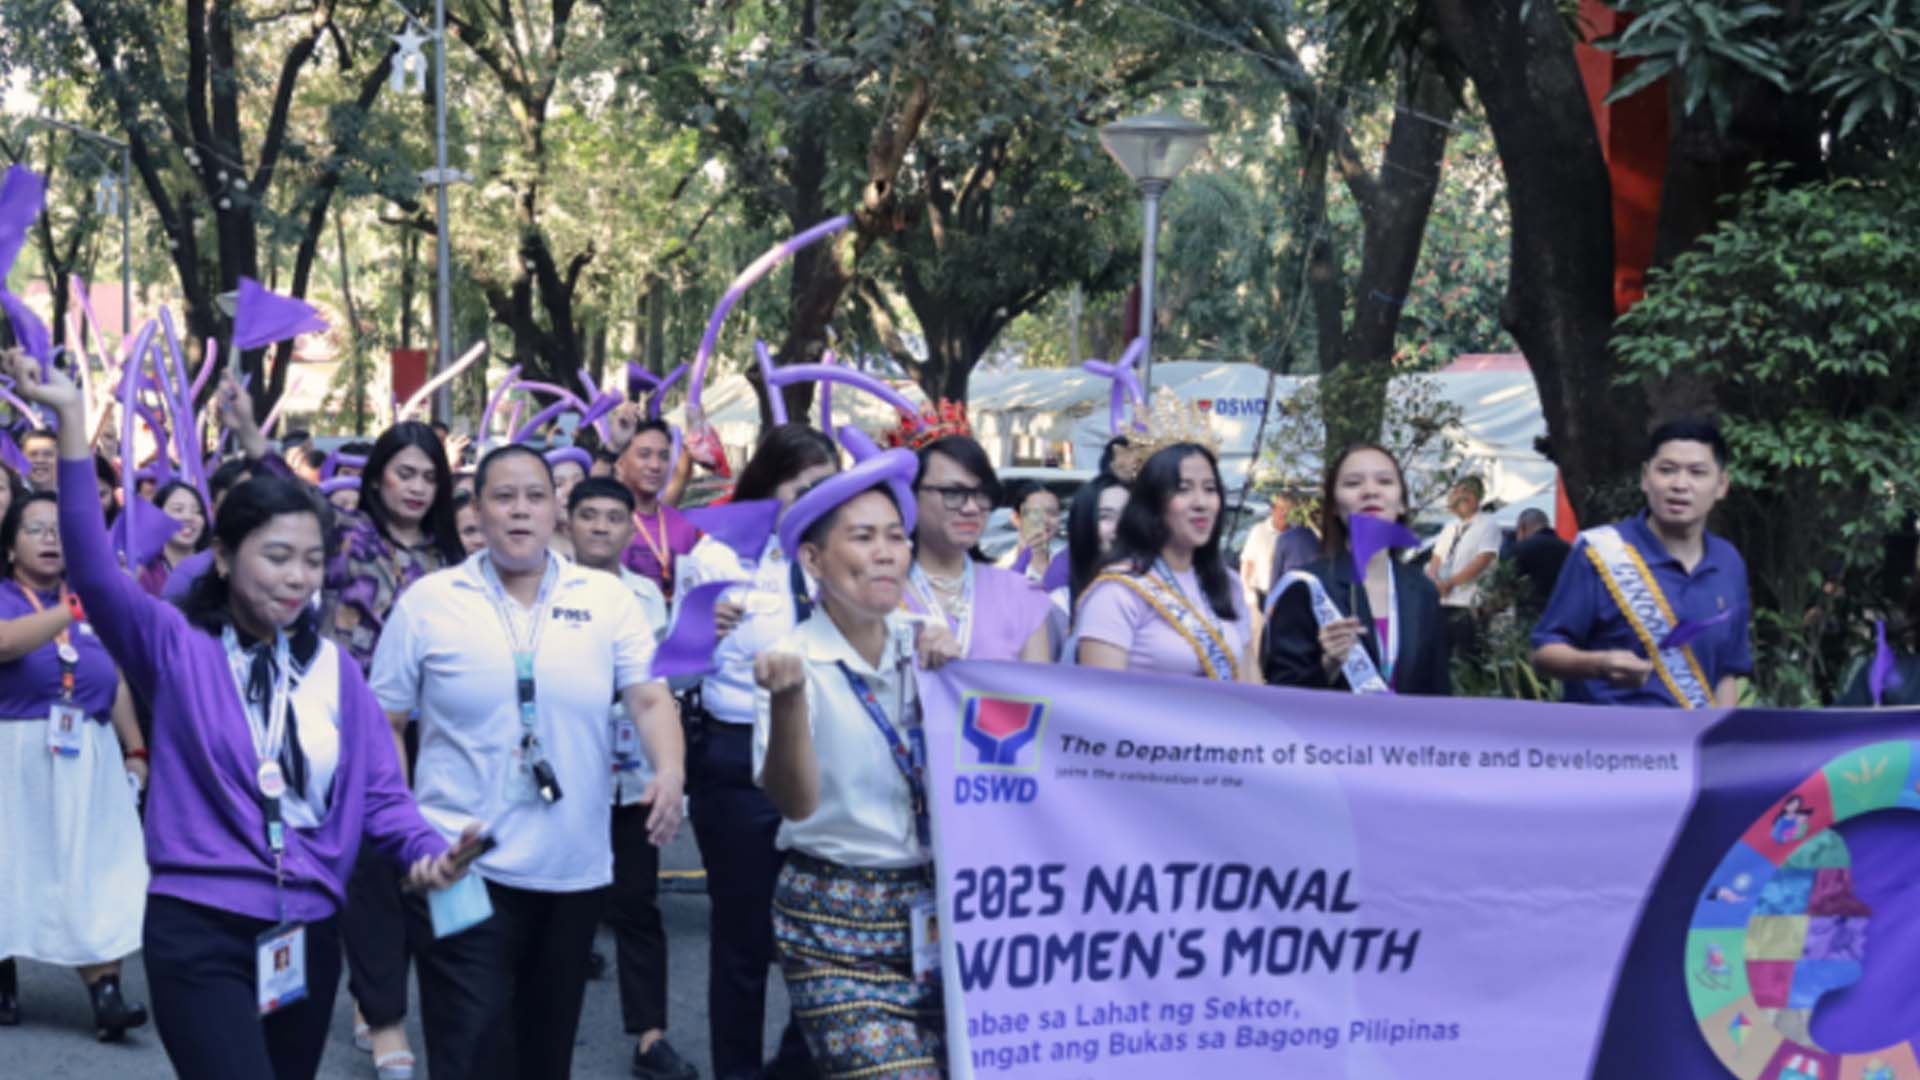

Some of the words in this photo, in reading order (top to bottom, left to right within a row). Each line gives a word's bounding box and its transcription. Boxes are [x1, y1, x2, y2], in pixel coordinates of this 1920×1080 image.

[1060, 733, 1106, 756] The
[1115, 739, 1264, 763] Department
[1272, 744, 1297, 764] of
[1304, 744, 1372, 765] Social
[1381, 746, 1471, 767] Welfare
[1478, 750, 1520, 767] and
[1527, 748, 1679, 771] Development
[955, 775, 1038, 804] DSWD
[1093, 767, 1116, 779] the
[1120, 771, 1199, 784] celebration
[1203, 774, 1218, 785] of
[1221, 774, 1243, 787] the
[953, 863, 1067, 923] 2025
[1082, 863, 1361, 915] NATIONAL
[955, 927, 1207, 992] WOMEN'S
[1221, 926, 1420, 978] MONTH
[967, 1011, 1029, 1038] abae
[1038, 1010, 1067, 1029] sa
[1076, 1000, 1150, 1027] Lahat
[1159, 1002, 1195, 1026] ng
[1204, 996, 1300, 1020] Sektor,
[1050, 1039, 1099, 1062] ang
[1109, 1031, 1188, 1056] Bukas
[1196, 1031, 1226, 1049] sa
[1235, 1024, 1341, 1051] Bagong
[1350, 1018, 1461, 1046] Pilipinas
